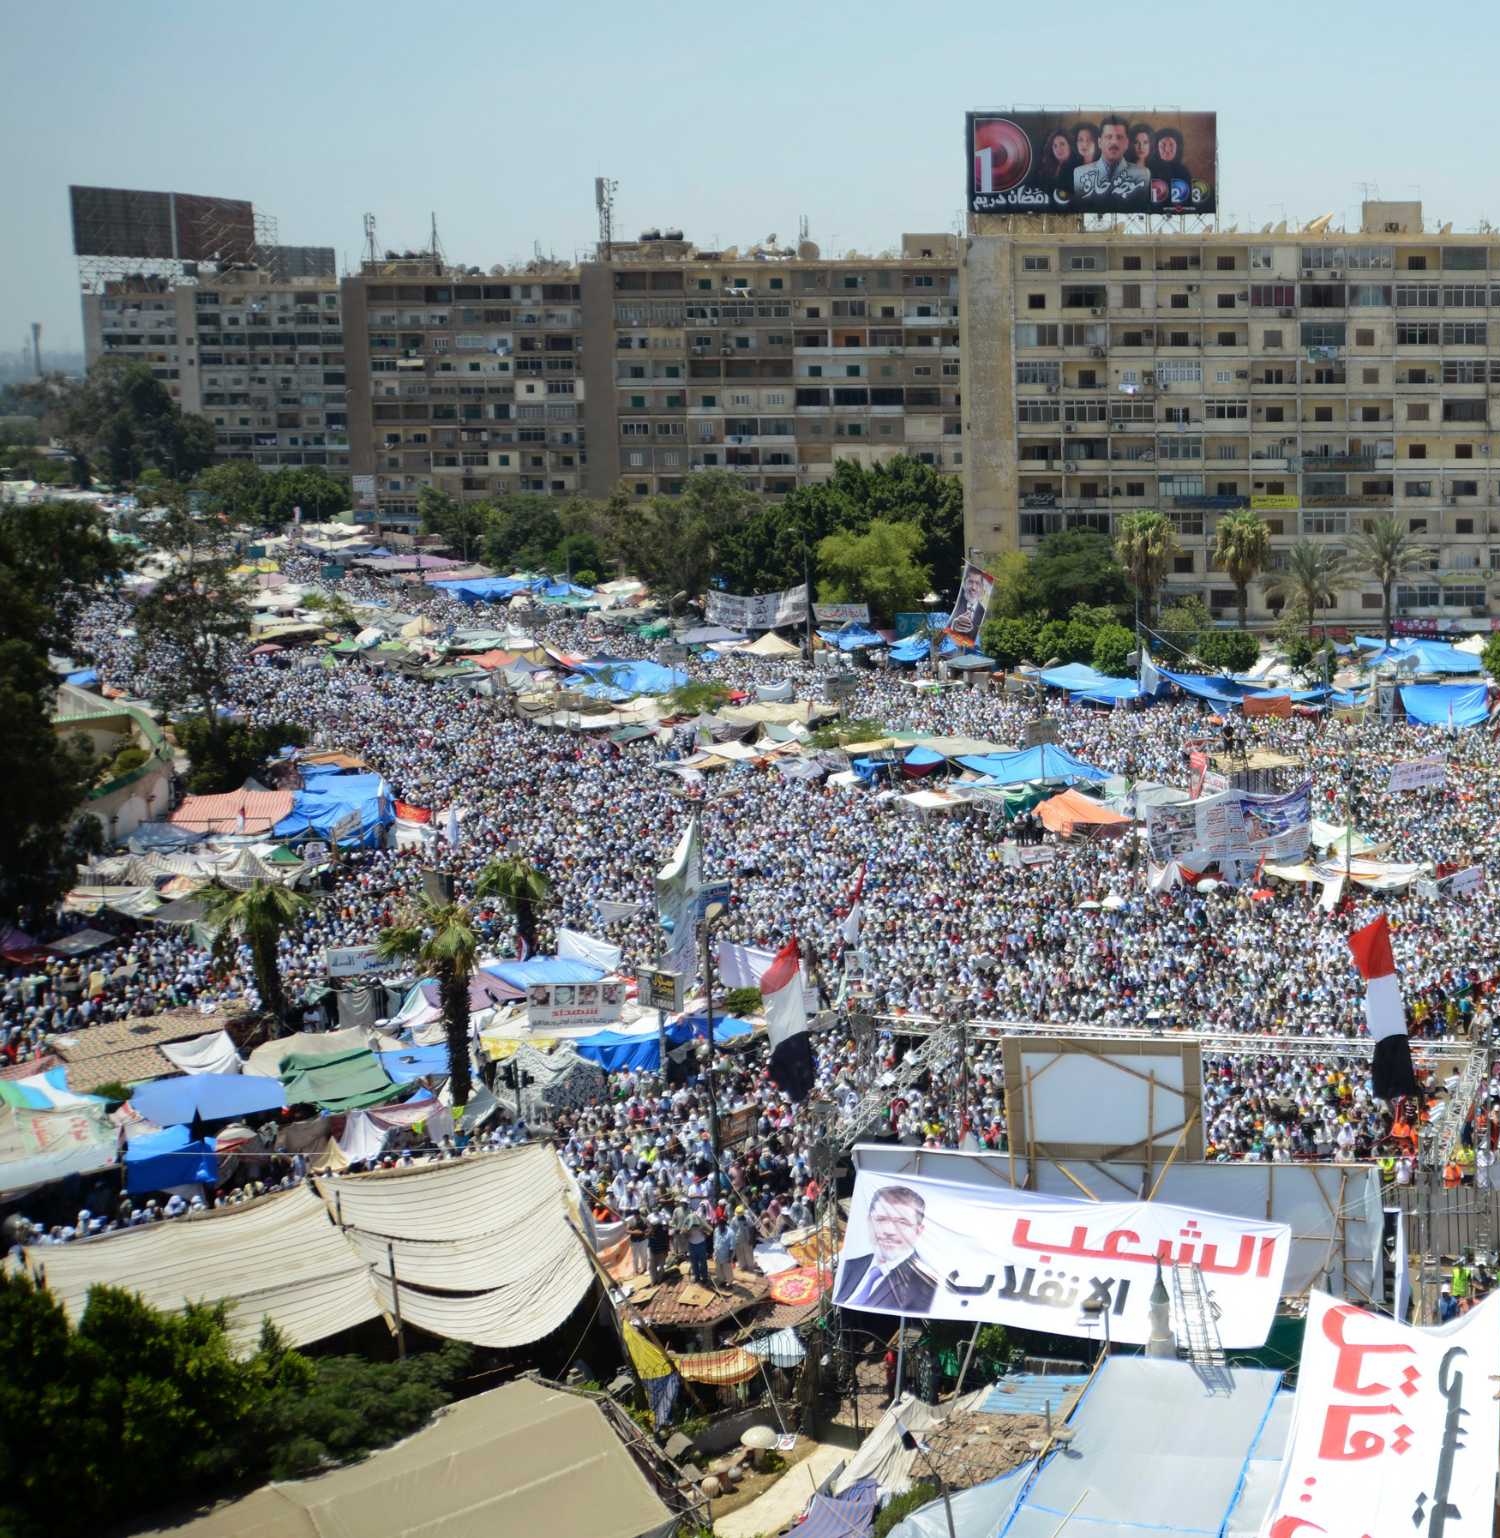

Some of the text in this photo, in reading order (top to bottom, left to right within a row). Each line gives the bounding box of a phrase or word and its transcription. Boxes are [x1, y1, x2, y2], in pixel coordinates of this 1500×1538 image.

[973, 185, 1049, 211] رمضان دريم
[1011, 1218, 1277, 1278] الشعب
